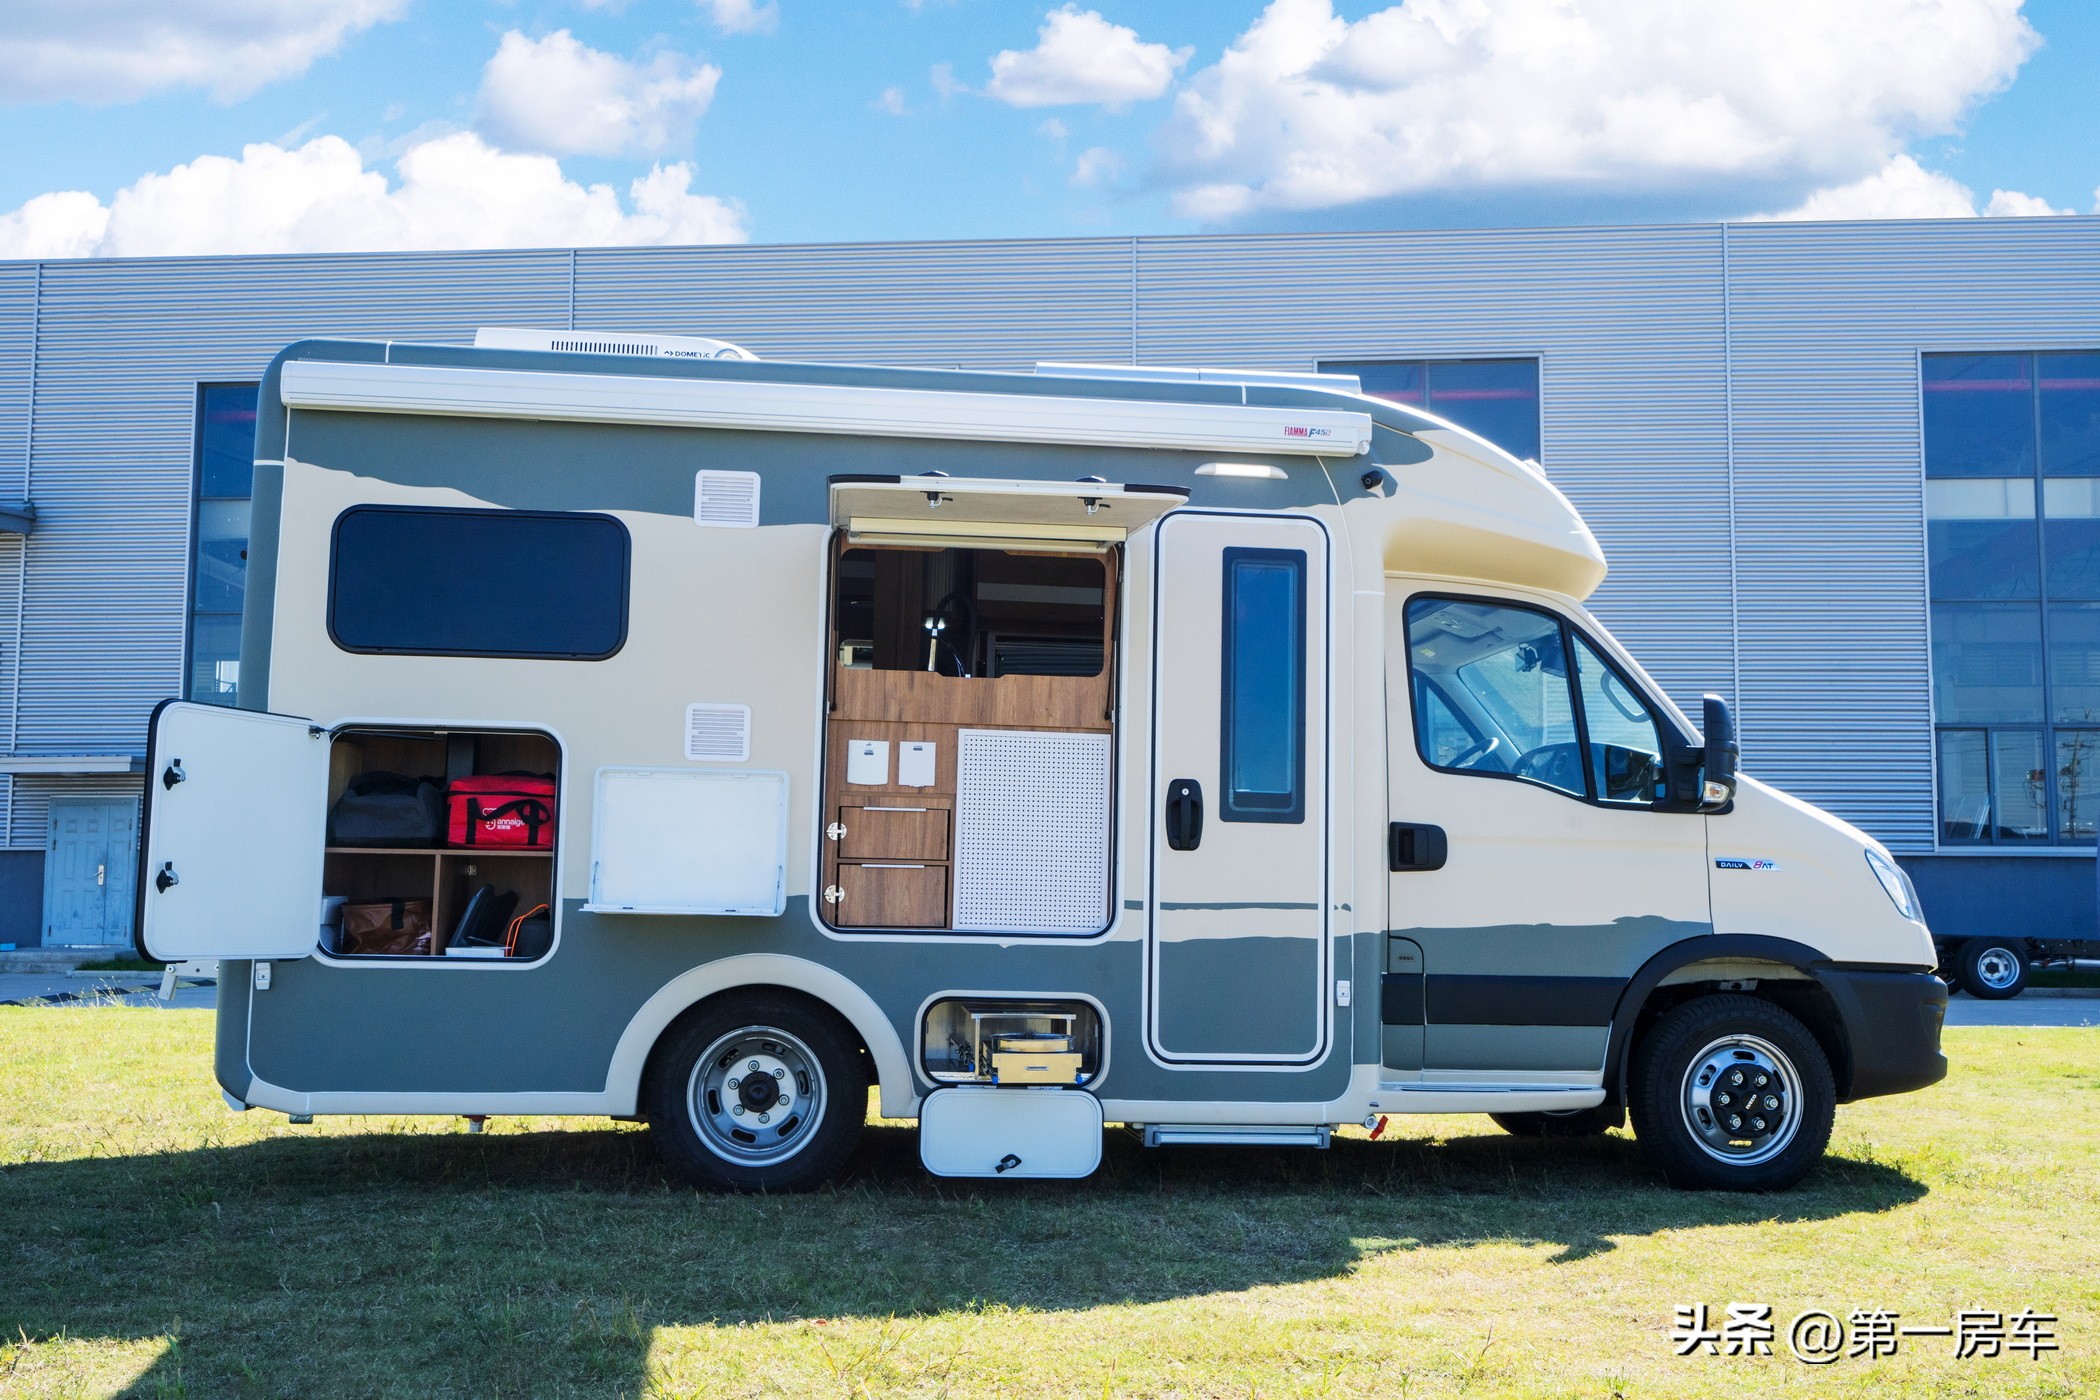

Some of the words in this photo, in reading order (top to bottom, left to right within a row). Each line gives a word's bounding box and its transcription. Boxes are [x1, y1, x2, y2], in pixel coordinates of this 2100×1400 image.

[674, 350, 711, 359] DOMETIC
[1284, 426, 1308, 438] FIAMMA
[1720, 861, 1744, 869] DAILY
[1753, 860, 1774, 870] 8AT
